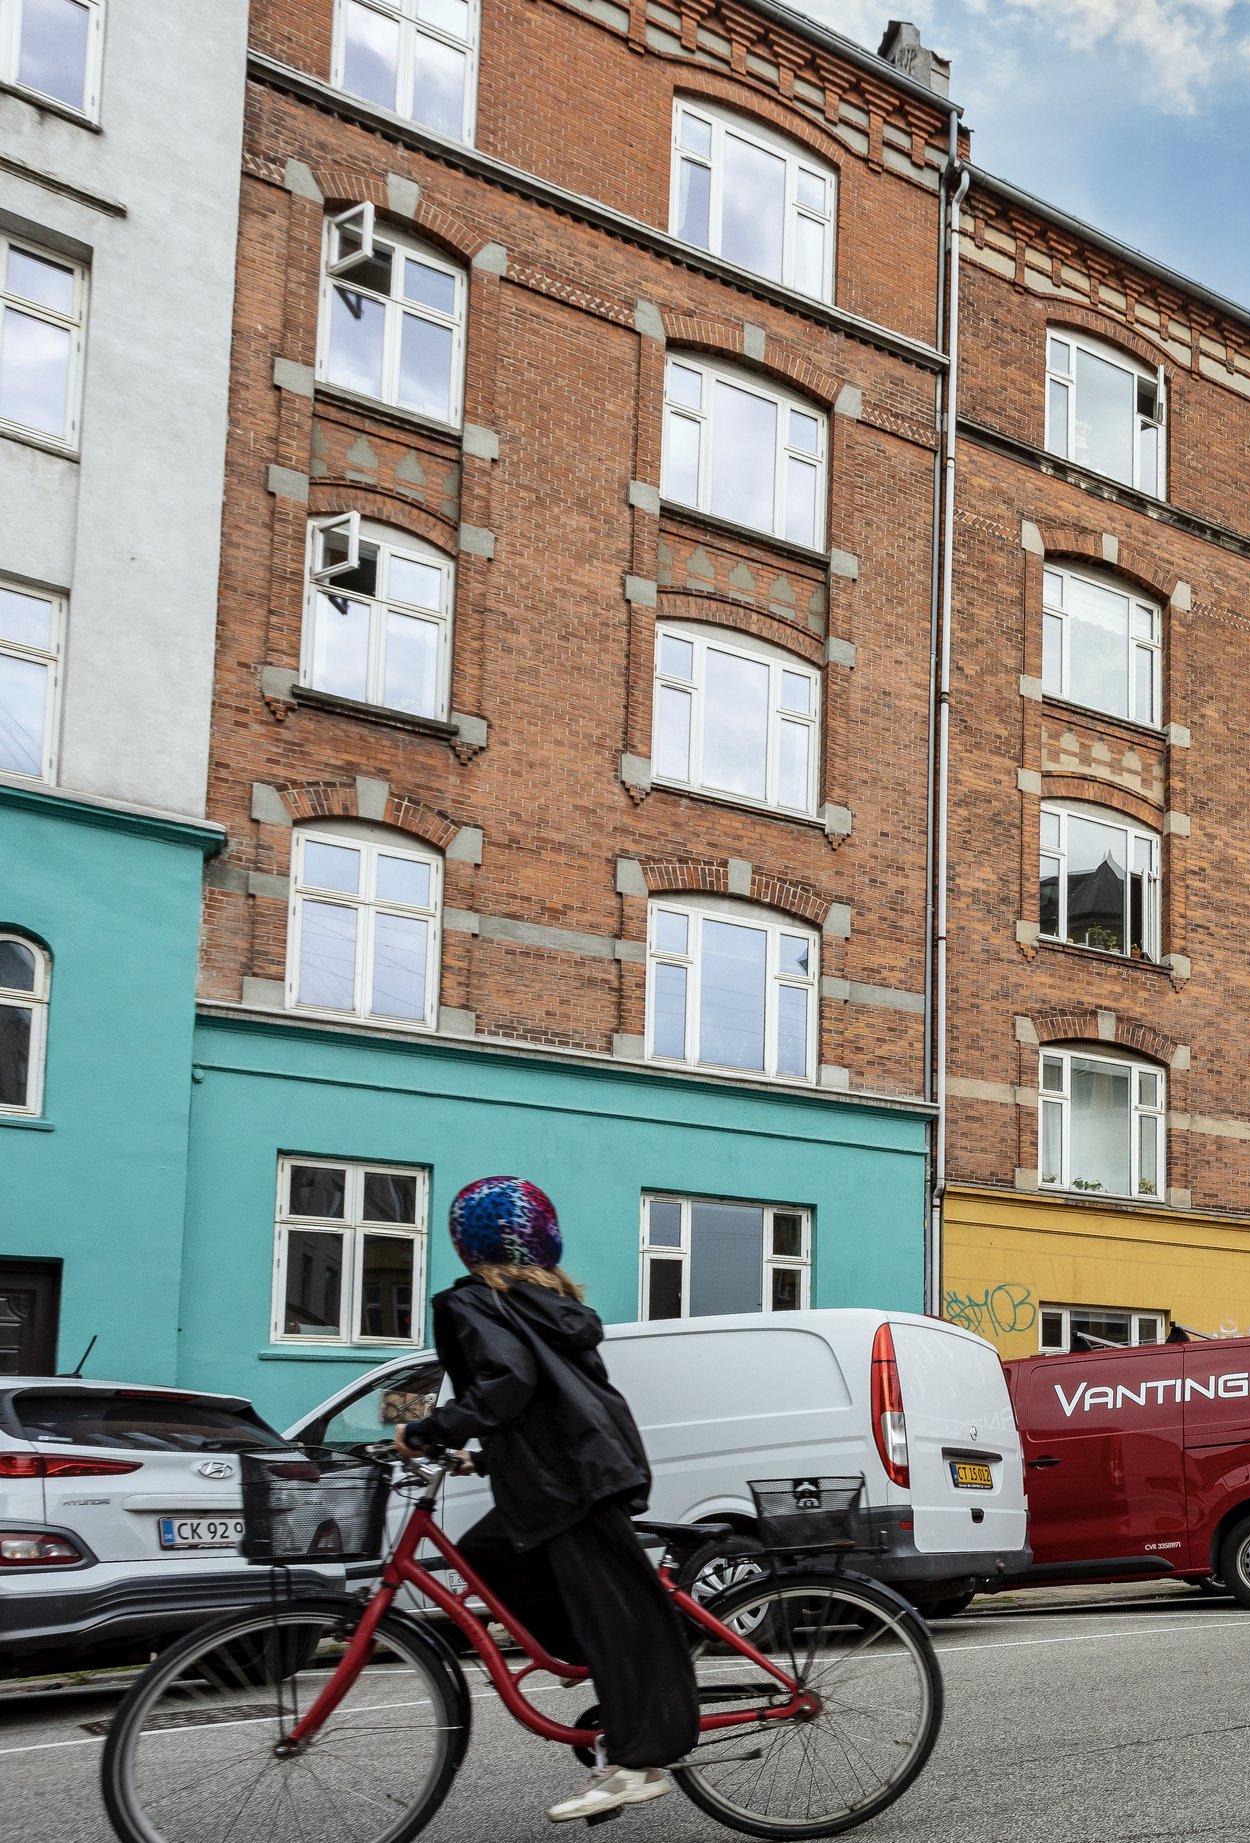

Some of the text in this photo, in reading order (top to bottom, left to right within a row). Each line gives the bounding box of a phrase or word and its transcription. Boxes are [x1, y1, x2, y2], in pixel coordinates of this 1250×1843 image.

[957, 1466, 968, 1480] CT
[62, 1498, 111, 1507] HYUNDAI
[177, 1522, 203, 1540] CK
[207, 1522, 230, 1540] 92
